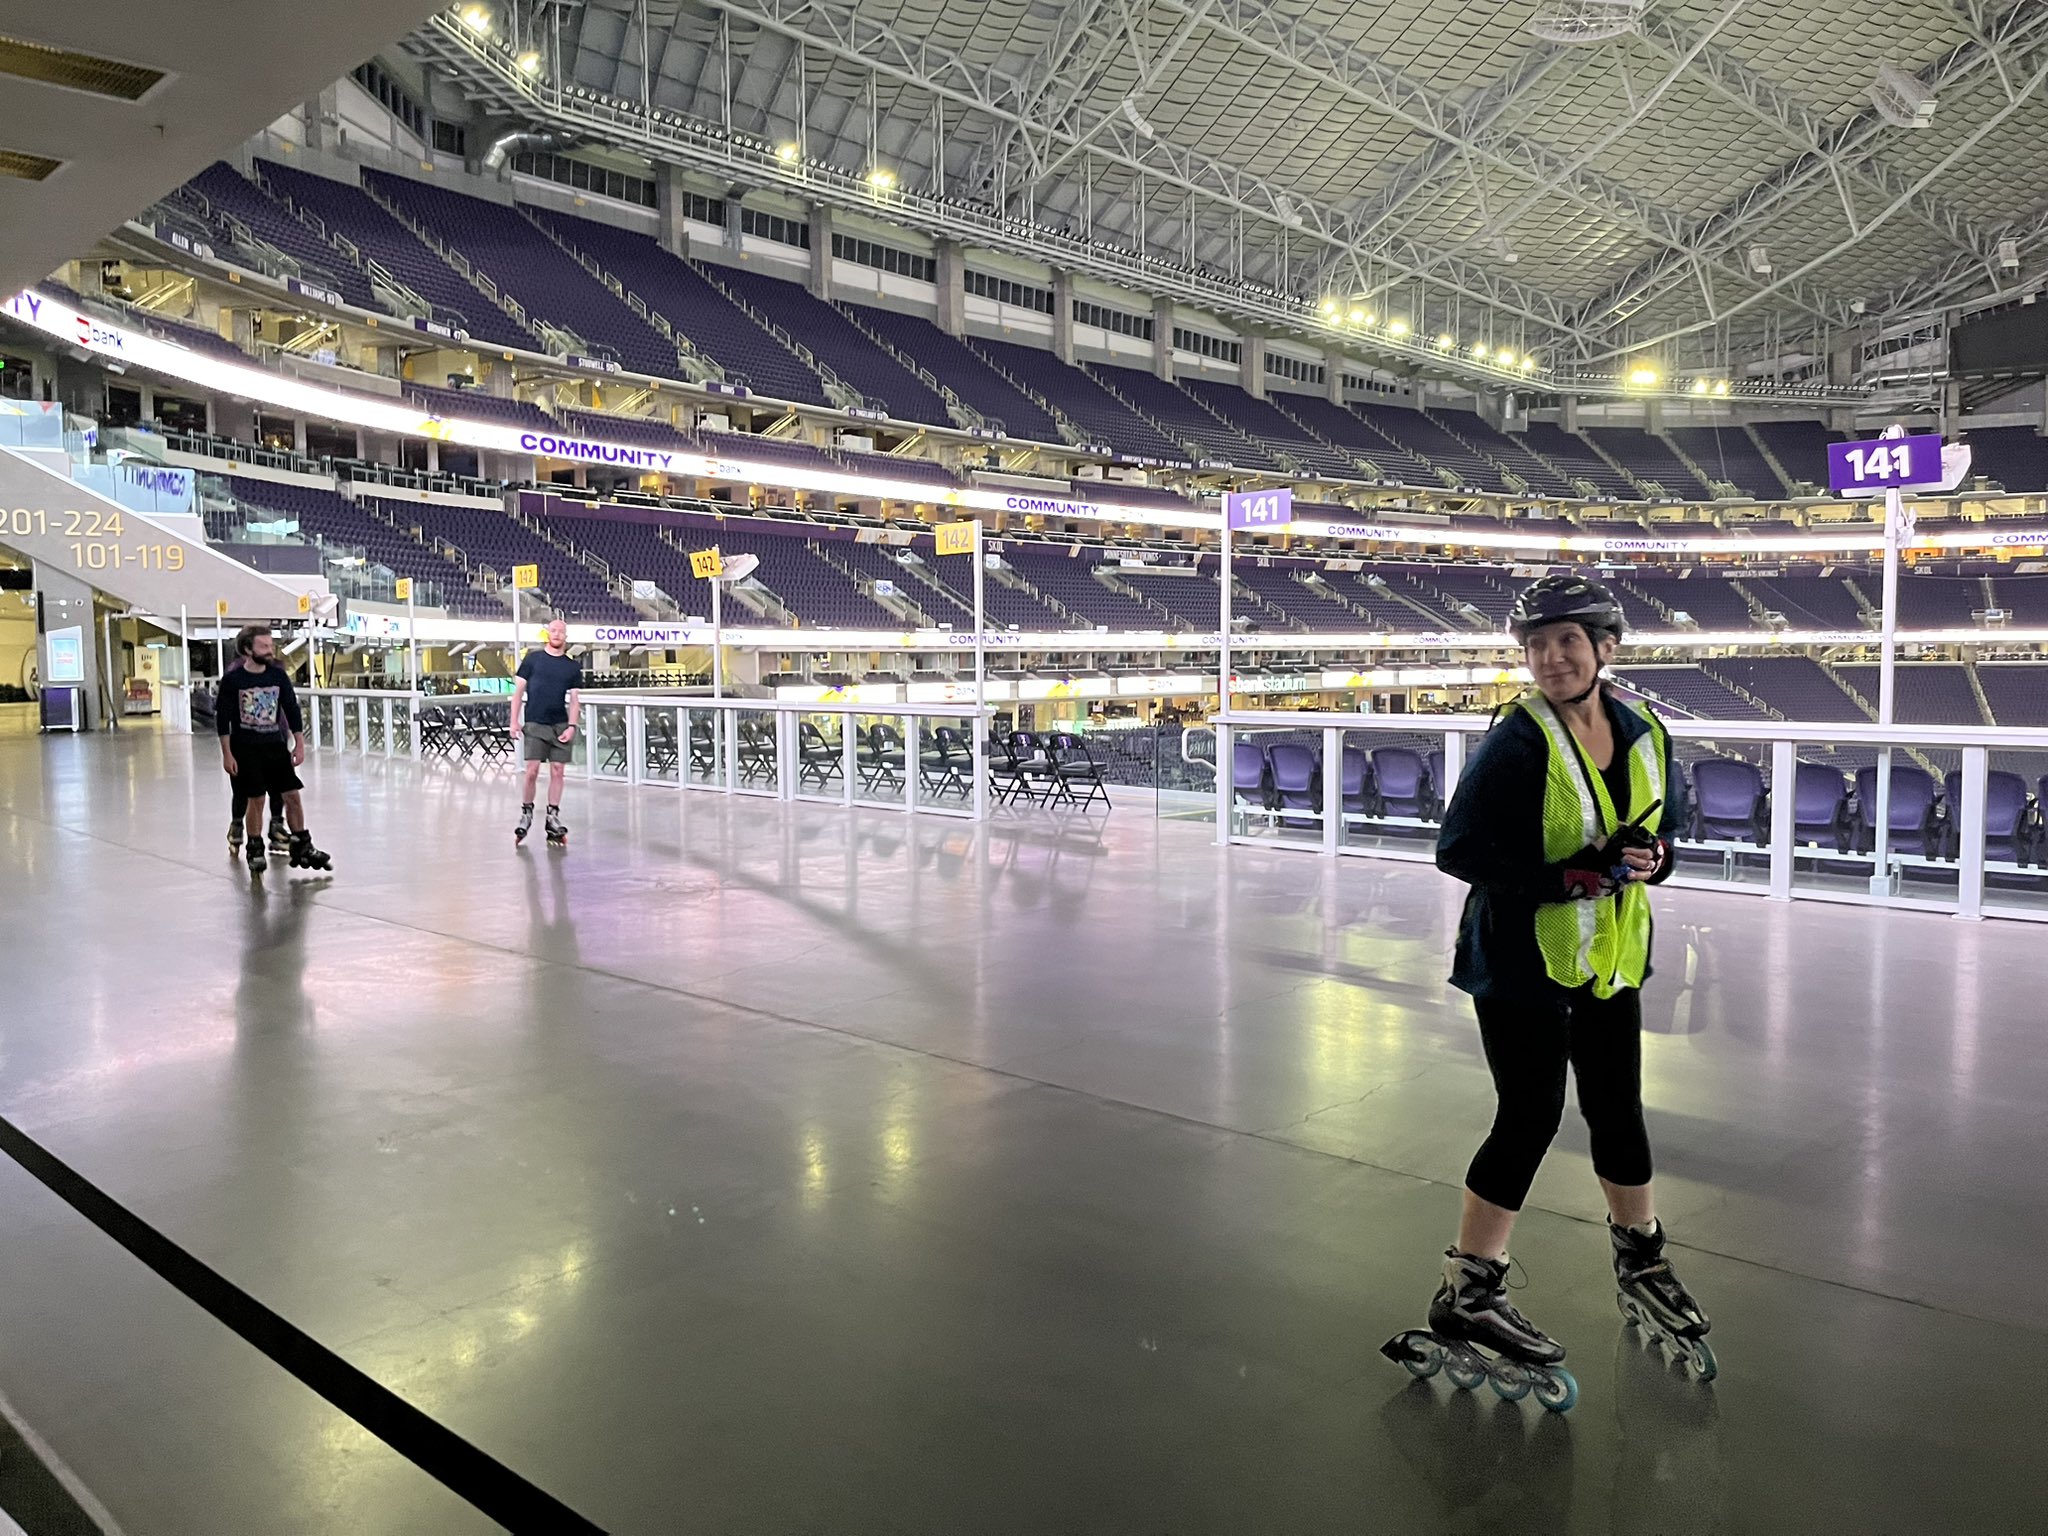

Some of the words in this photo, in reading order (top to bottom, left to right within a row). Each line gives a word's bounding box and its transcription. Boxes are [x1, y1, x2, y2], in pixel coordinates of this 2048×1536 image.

[93, 324, 123, 350] bank
[520, 434, 673, 468] COMMUNITY
[1845, 445, 1911, 481] 141
[1006, 497, 1100, 516] COMMUNITY
[1240, 495, 1279, 523] 141
[942, 527, 969, 549] 142
[1328, 525, 1400, 539] COMMUNITY
[988, 540, 1005, 553] SKOL
[1604, 540, 1689, 550] COMMUNITY
[70, 542, 185, 571] 101-119
[696, 555, 715, 573] 142
[518, 569, 534, 585] 142
[1914, 566, 1933, 575] SKOL
[595, 627, 692, 642] COMMUNITY
[1202, 636, 1260, 645] COMUNITY
